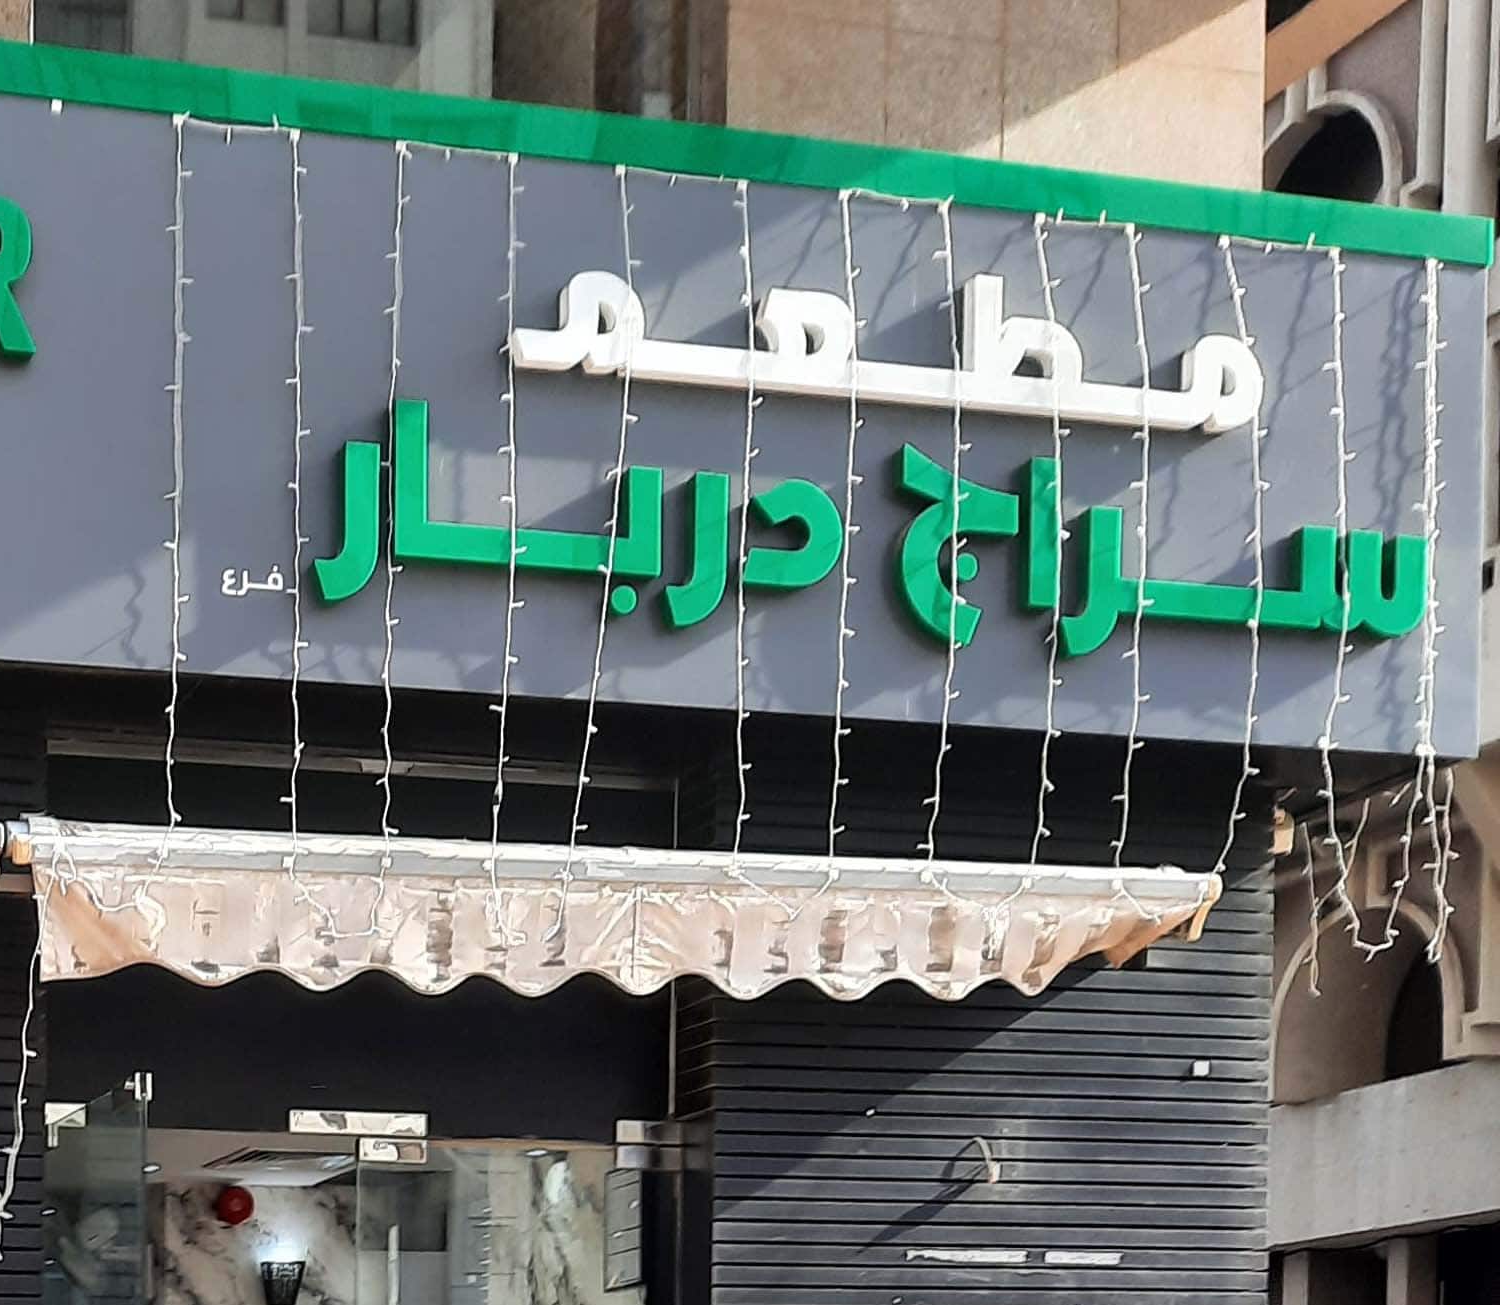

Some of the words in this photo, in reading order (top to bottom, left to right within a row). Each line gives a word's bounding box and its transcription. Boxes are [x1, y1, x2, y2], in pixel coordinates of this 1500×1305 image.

[511, 269, 1264, 433] مطعم
[221, 565, 284, 596] فرع
[314, 398, 844, 629] دربار
[896, 442, 1427, 659] سراج
